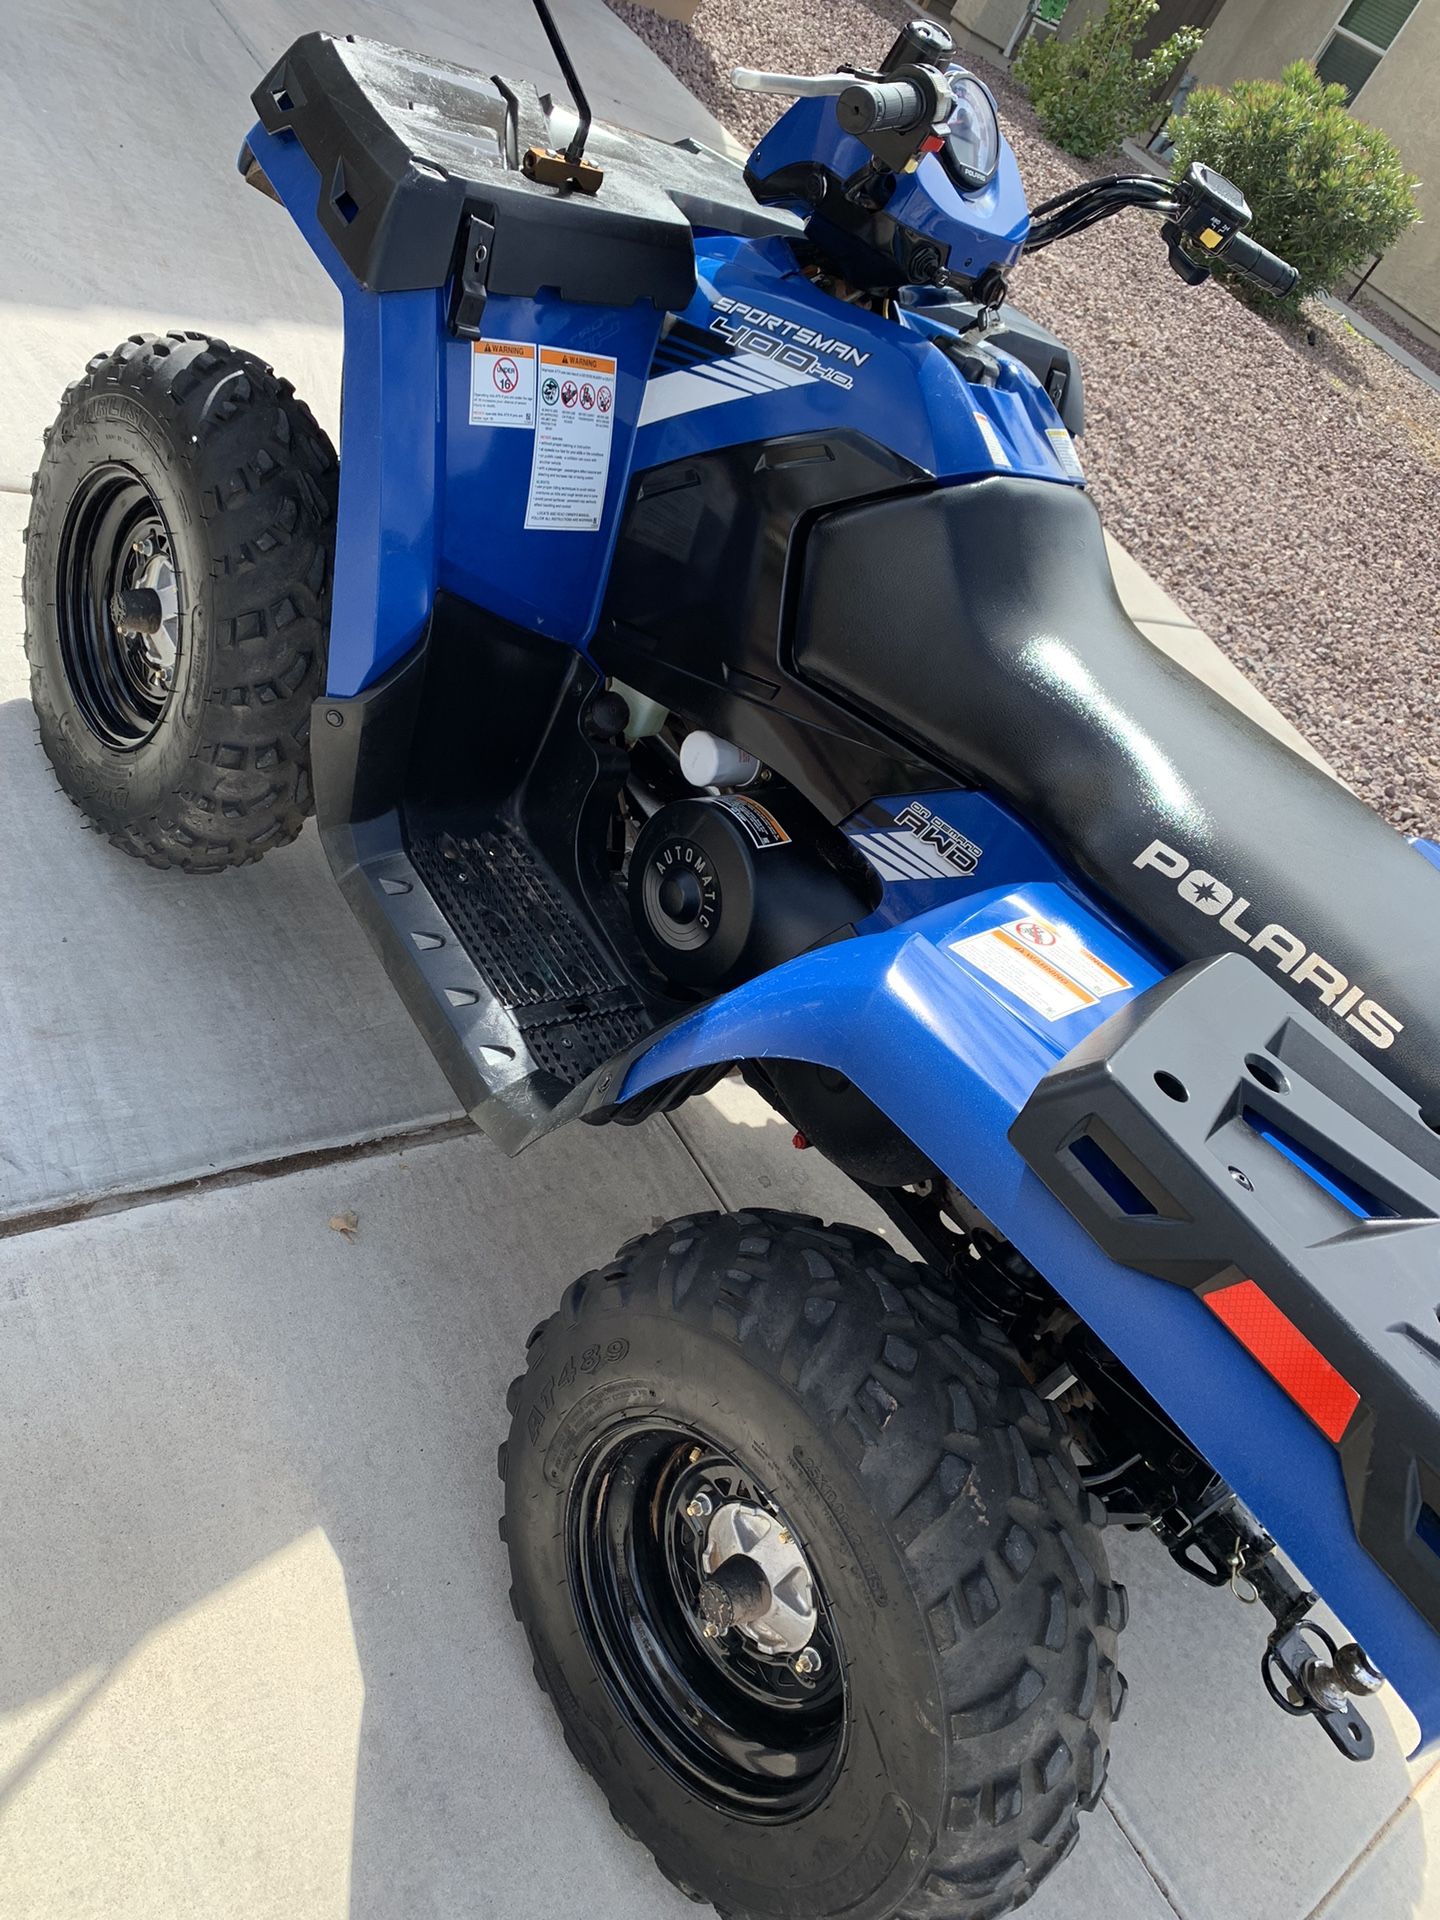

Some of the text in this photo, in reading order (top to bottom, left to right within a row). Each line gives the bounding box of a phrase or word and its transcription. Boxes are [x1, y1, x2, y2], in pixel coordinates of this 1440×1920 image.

[491, 344, 525, 355] WARNING
[569, 356, 597, 368] WARNING
[709, 316, 820, 374] 400
[712, 296, 872, 369] SPORTSMAN
[499, 379, 511, 390] 16
[893, 807, 979, 875] AWD
[655, 846, 716, 929] AUTOMATIC
[1024, 950, 1071, 986] WARNING
[1132, 838, 1404, 1050] POLARIS
[528, 1337, 630, 1447] AT489
